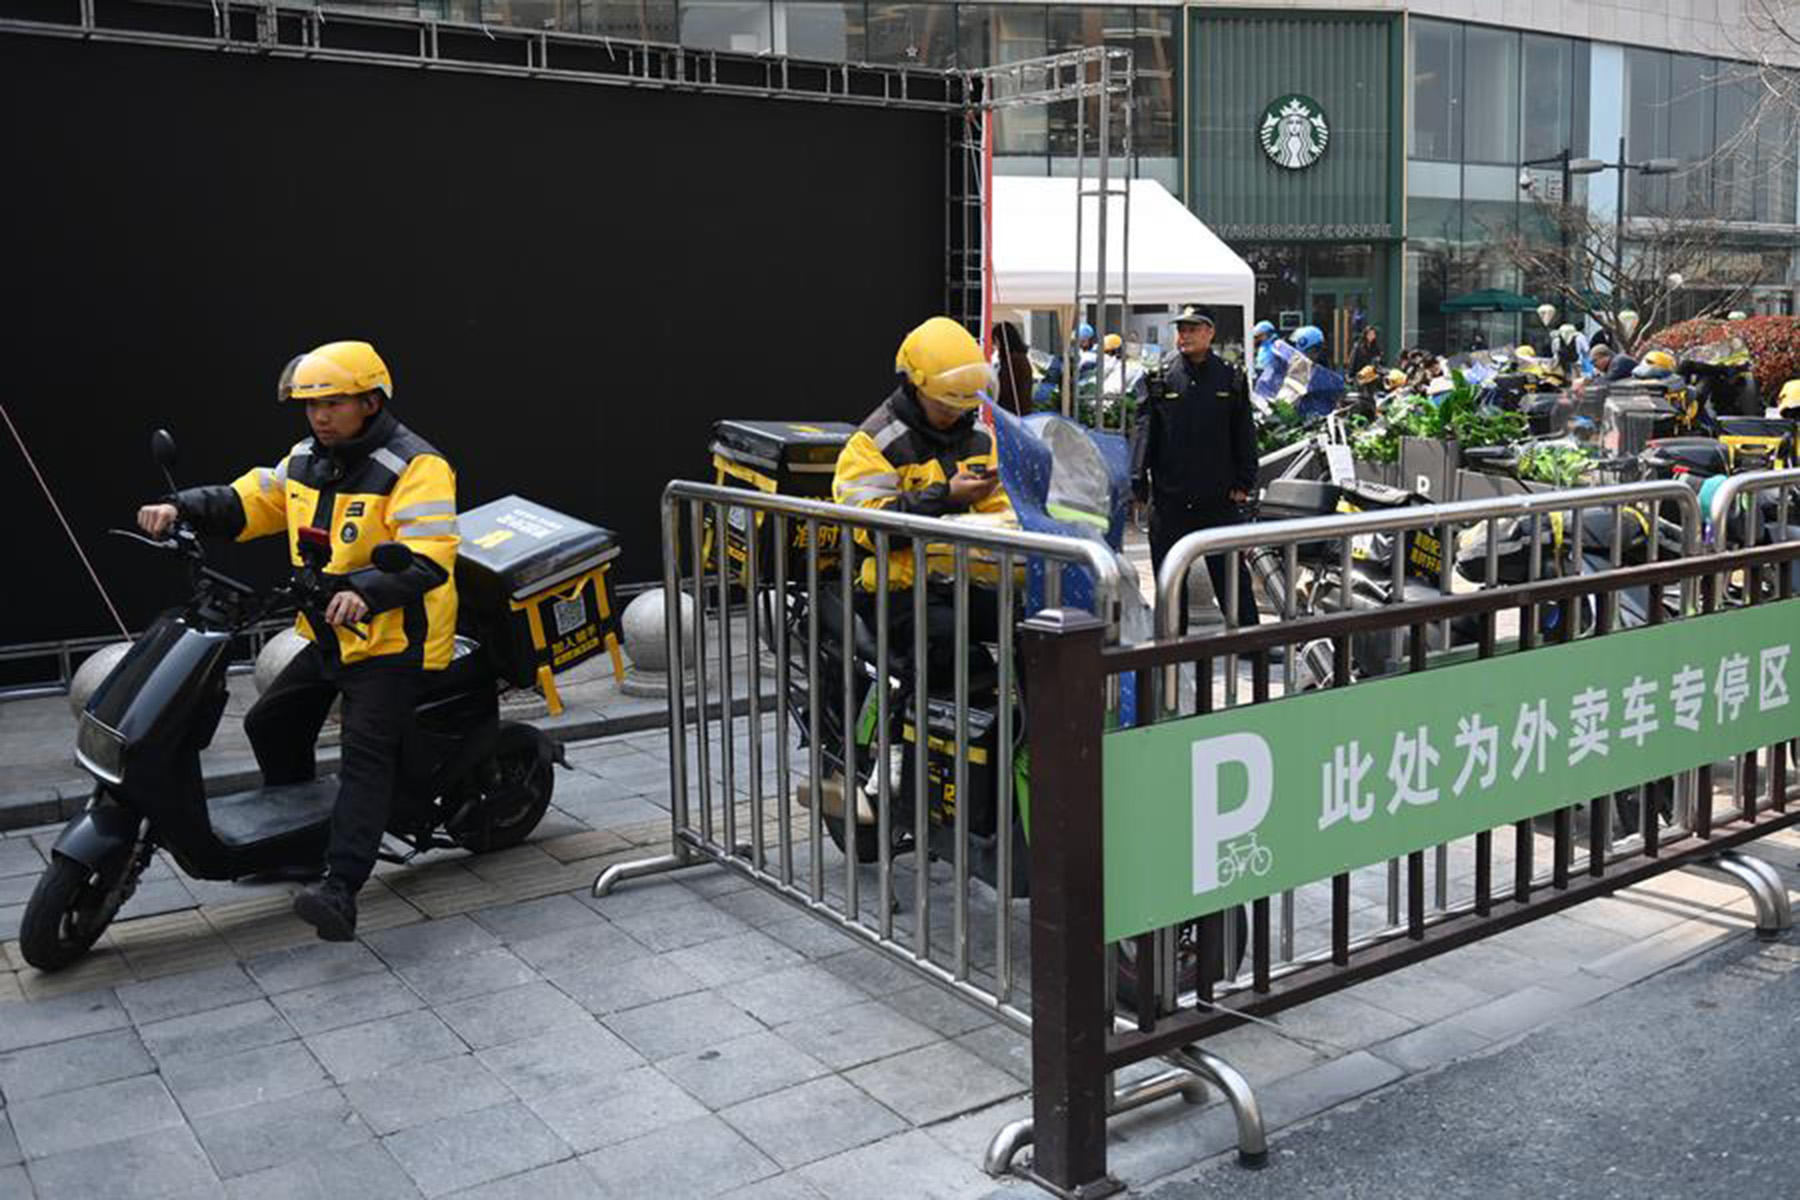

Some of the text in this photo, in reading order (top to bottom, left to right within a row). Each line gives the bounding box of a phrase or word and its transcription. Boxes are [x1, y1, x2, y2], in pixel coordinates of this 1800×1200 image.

[1192, 644, 1792, 895] P 此处为外卖车专停区
